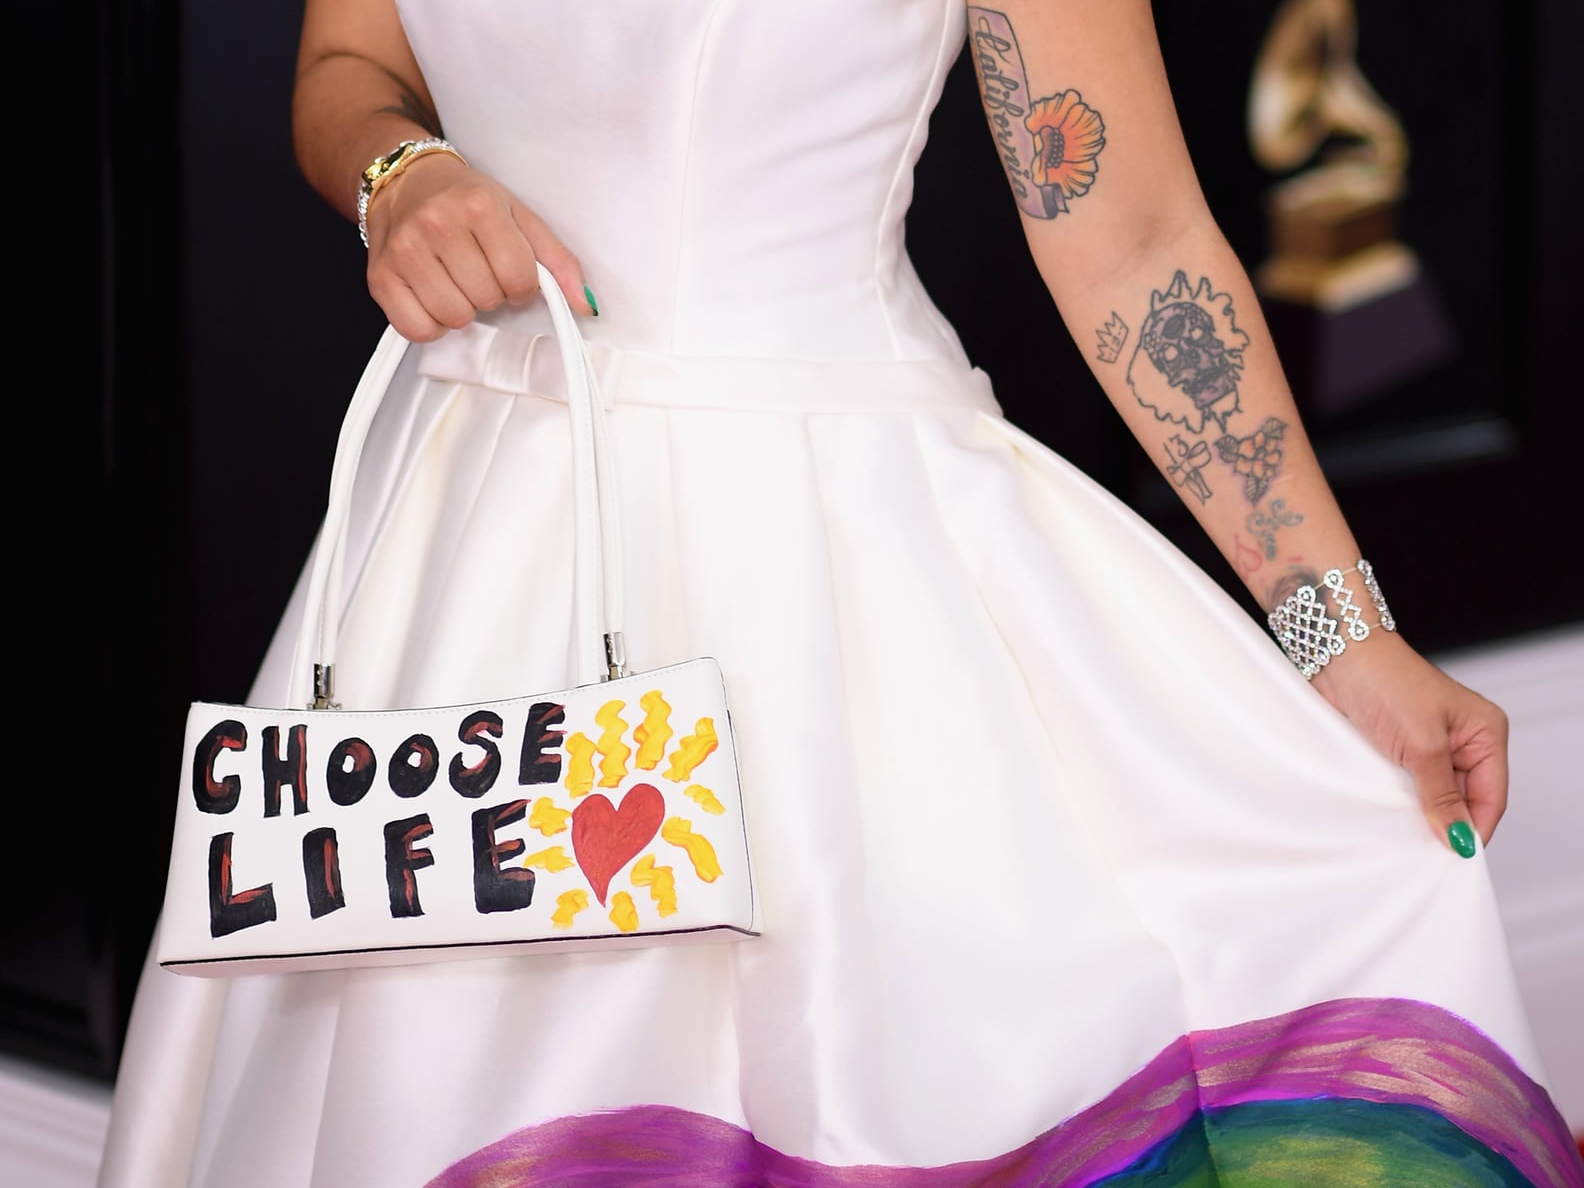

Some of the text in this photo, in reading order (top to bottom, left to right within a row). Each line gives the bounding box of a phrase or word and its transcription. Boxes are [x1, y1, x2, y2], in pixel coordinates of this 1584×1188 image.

[974, 16, 1029, 199] California
[193, 702, 566, 817] CHOOSE
[208, 799, 535, 938] LIFE
